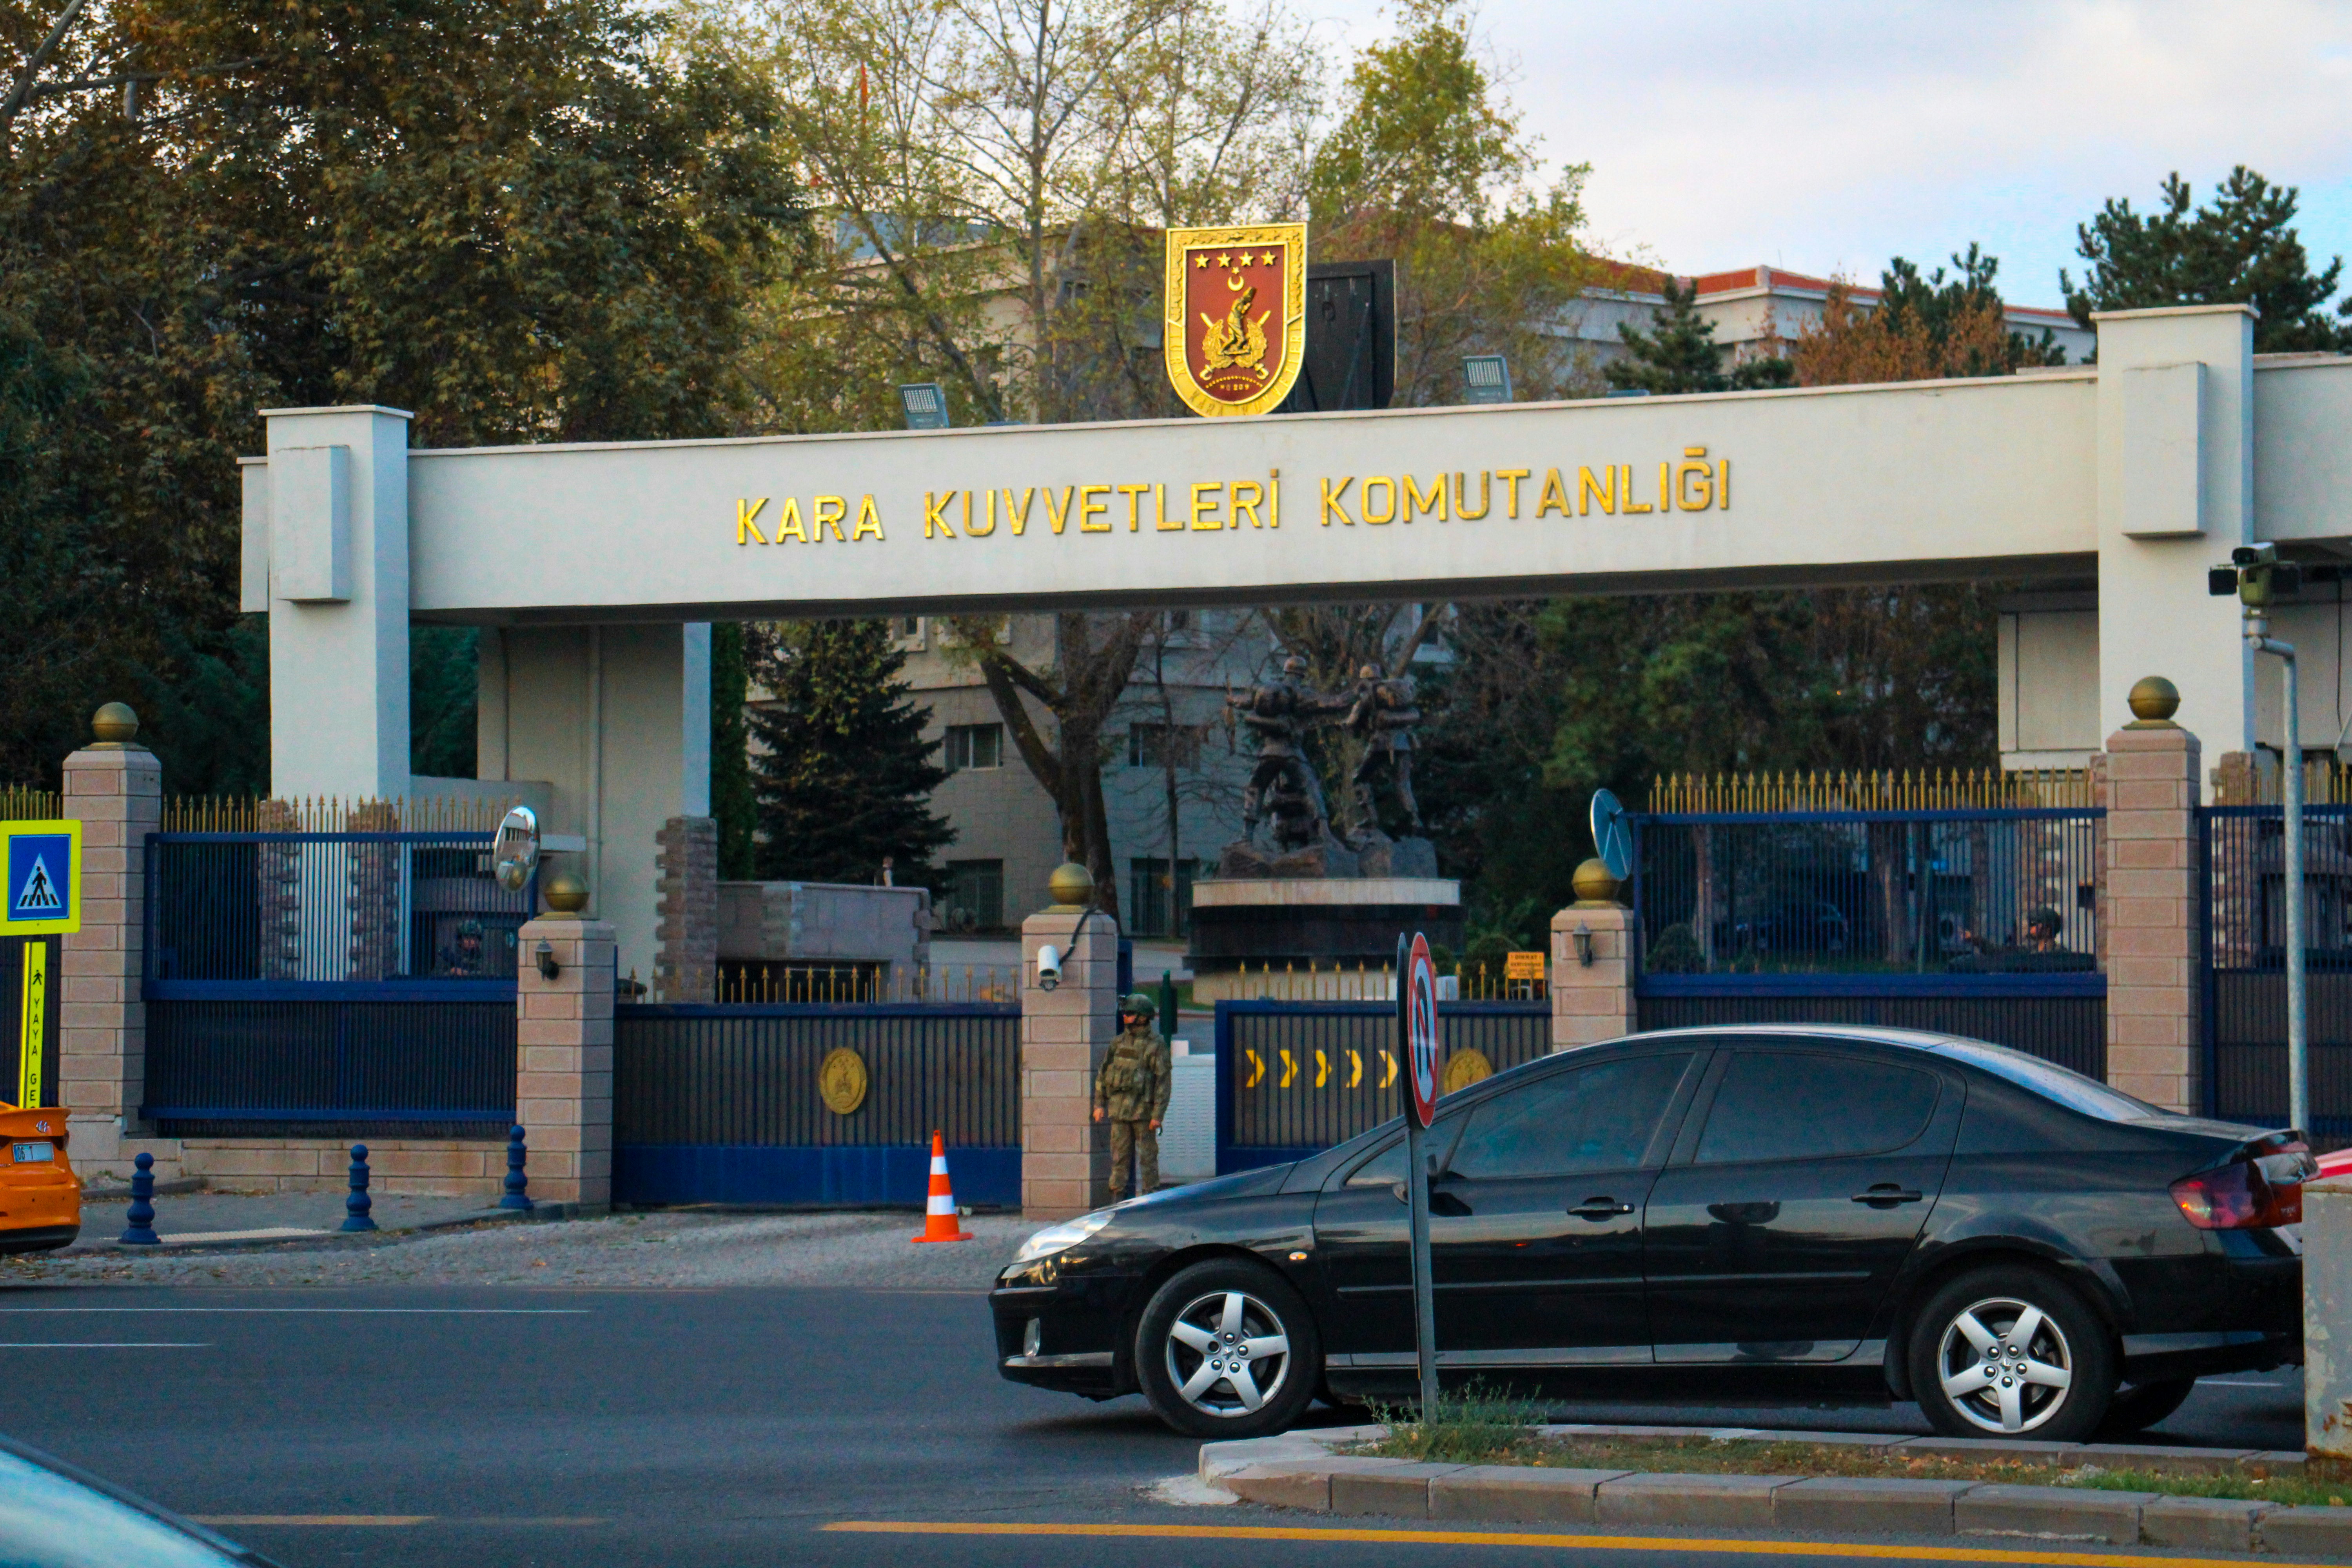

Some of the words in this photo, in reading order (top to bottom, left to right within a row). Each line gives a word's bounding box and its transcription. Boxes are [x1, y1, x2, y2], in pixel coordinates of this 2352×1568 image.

[737, 494, 883, 545] KARA
[924, 468, 1280, 538] KUVVETLERİ
[1320, 447, 1729, 526] KOMUTANLIĞI
[31, 998, 40, 1056] YAYA
